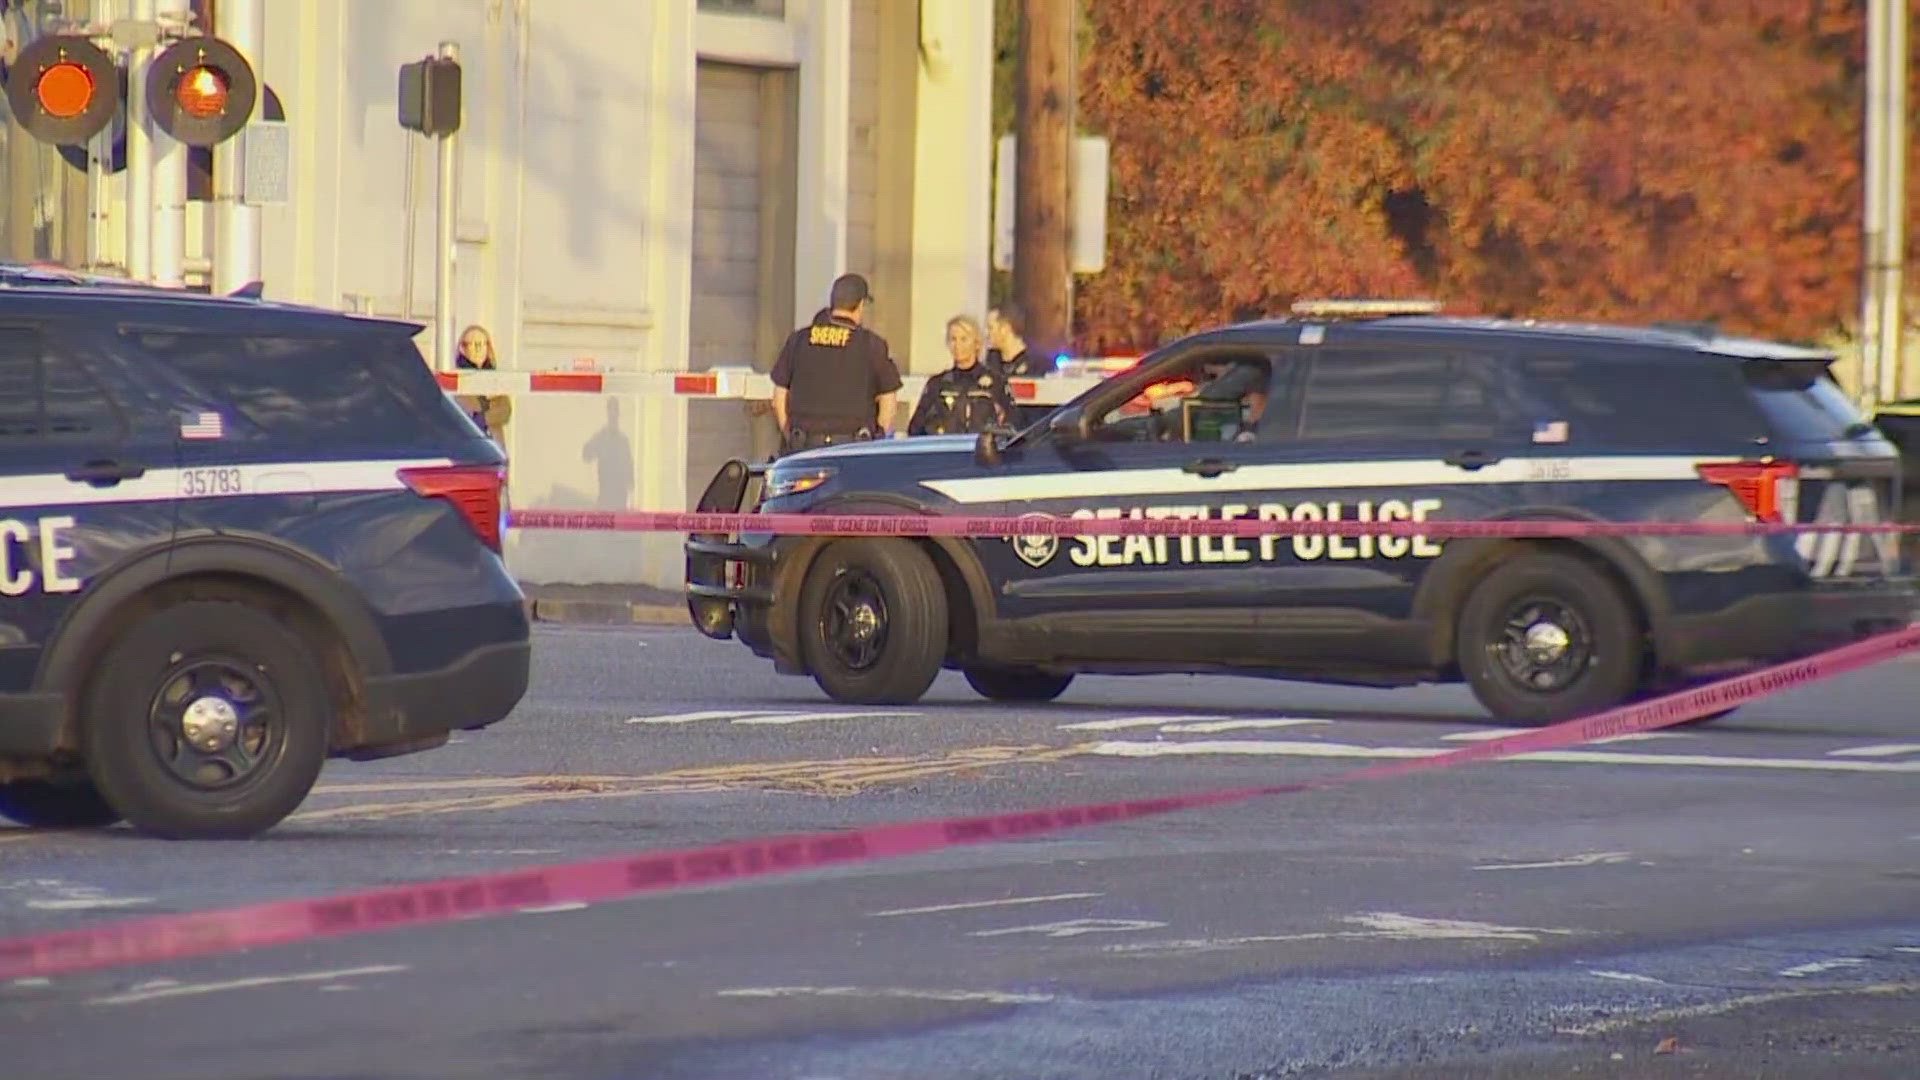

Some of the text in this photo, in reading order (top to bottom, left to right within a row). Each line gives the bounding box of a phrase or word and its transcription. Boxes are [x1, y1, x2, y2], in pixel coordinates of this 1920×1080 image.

[810, 326, 849, 347] SHERIFF
[183, 469, 242, 495] 35783
[837, 519, 865, 532] SCENE
[866, 519, 879, 532] DO
[880, 519, 897, 532] NOT
[899, 519, 929, 532] CROSS
[1070, 499, 1443, 567] SEATTLE POLICE
[0, 515, 80, 597] CE
